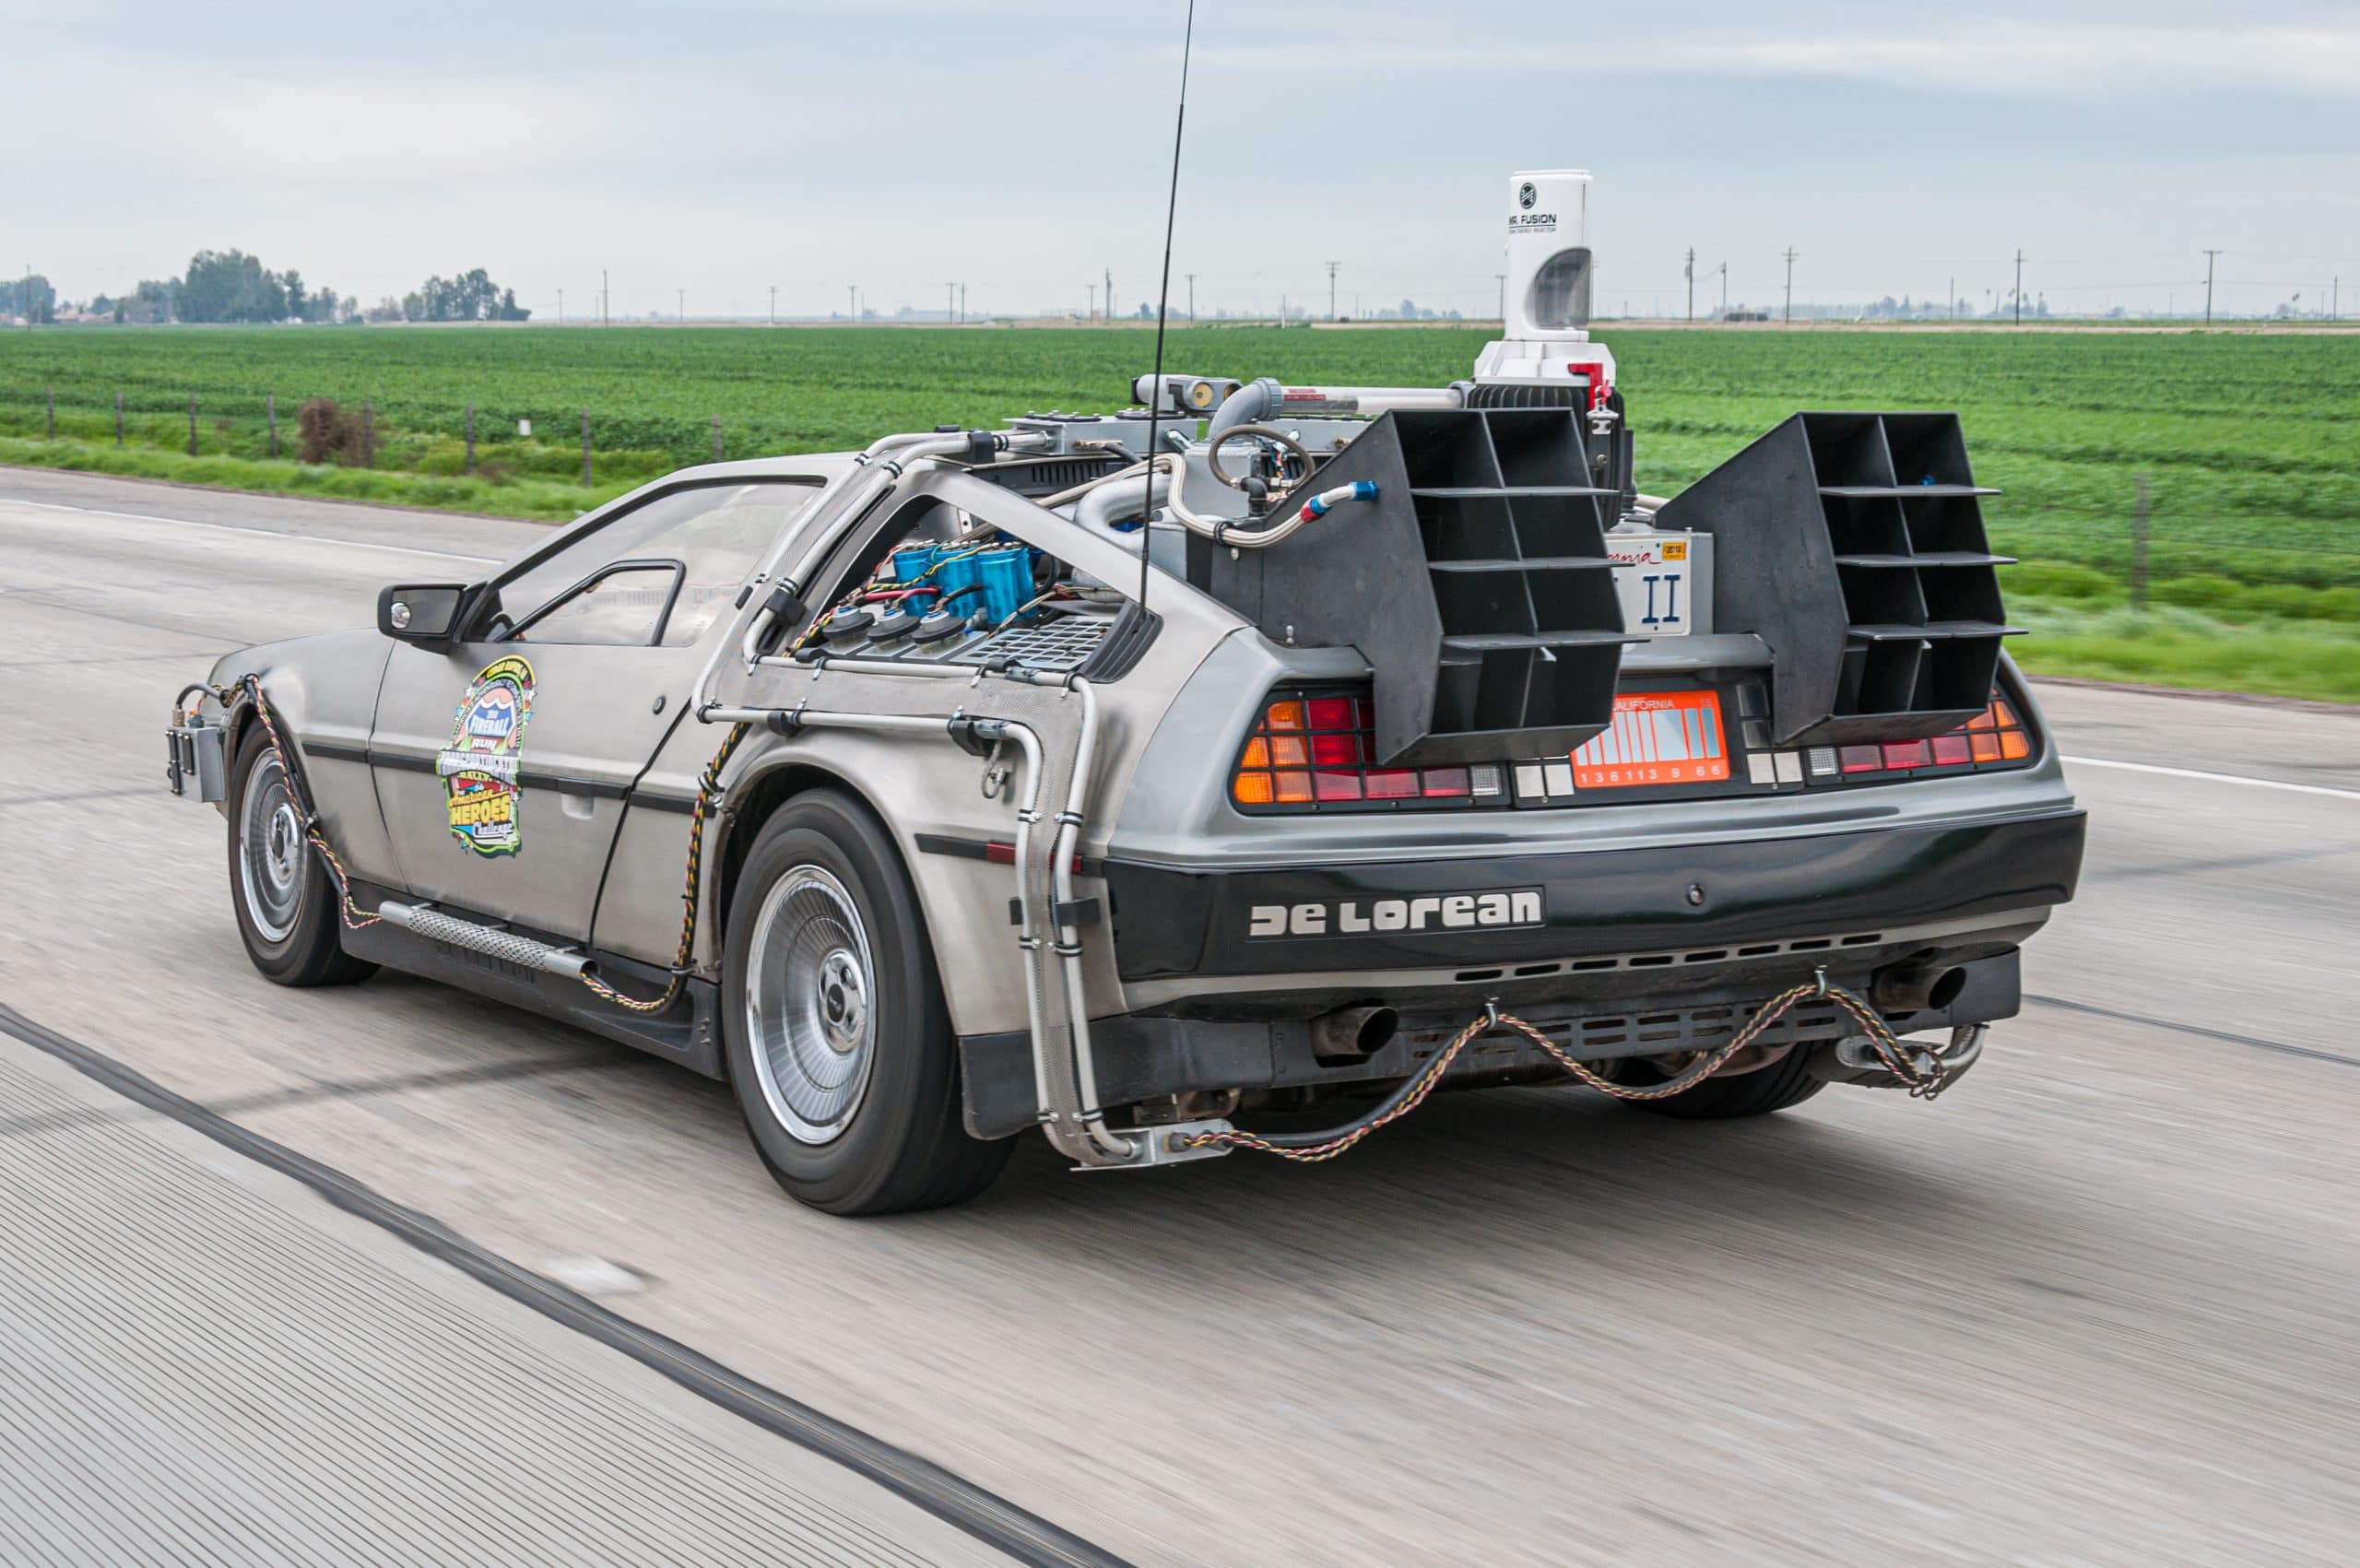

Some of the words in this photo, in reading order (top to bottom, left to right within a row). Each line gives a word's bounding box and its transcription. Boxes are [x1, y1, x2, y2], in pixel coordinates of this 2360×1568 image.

[1521, 214, 1556, 224] FUSION
[468, 715, 510, 737] FIREBALL
[470, 737, 498, 751] RUN
[451, 796, 510, 826] HEROES
